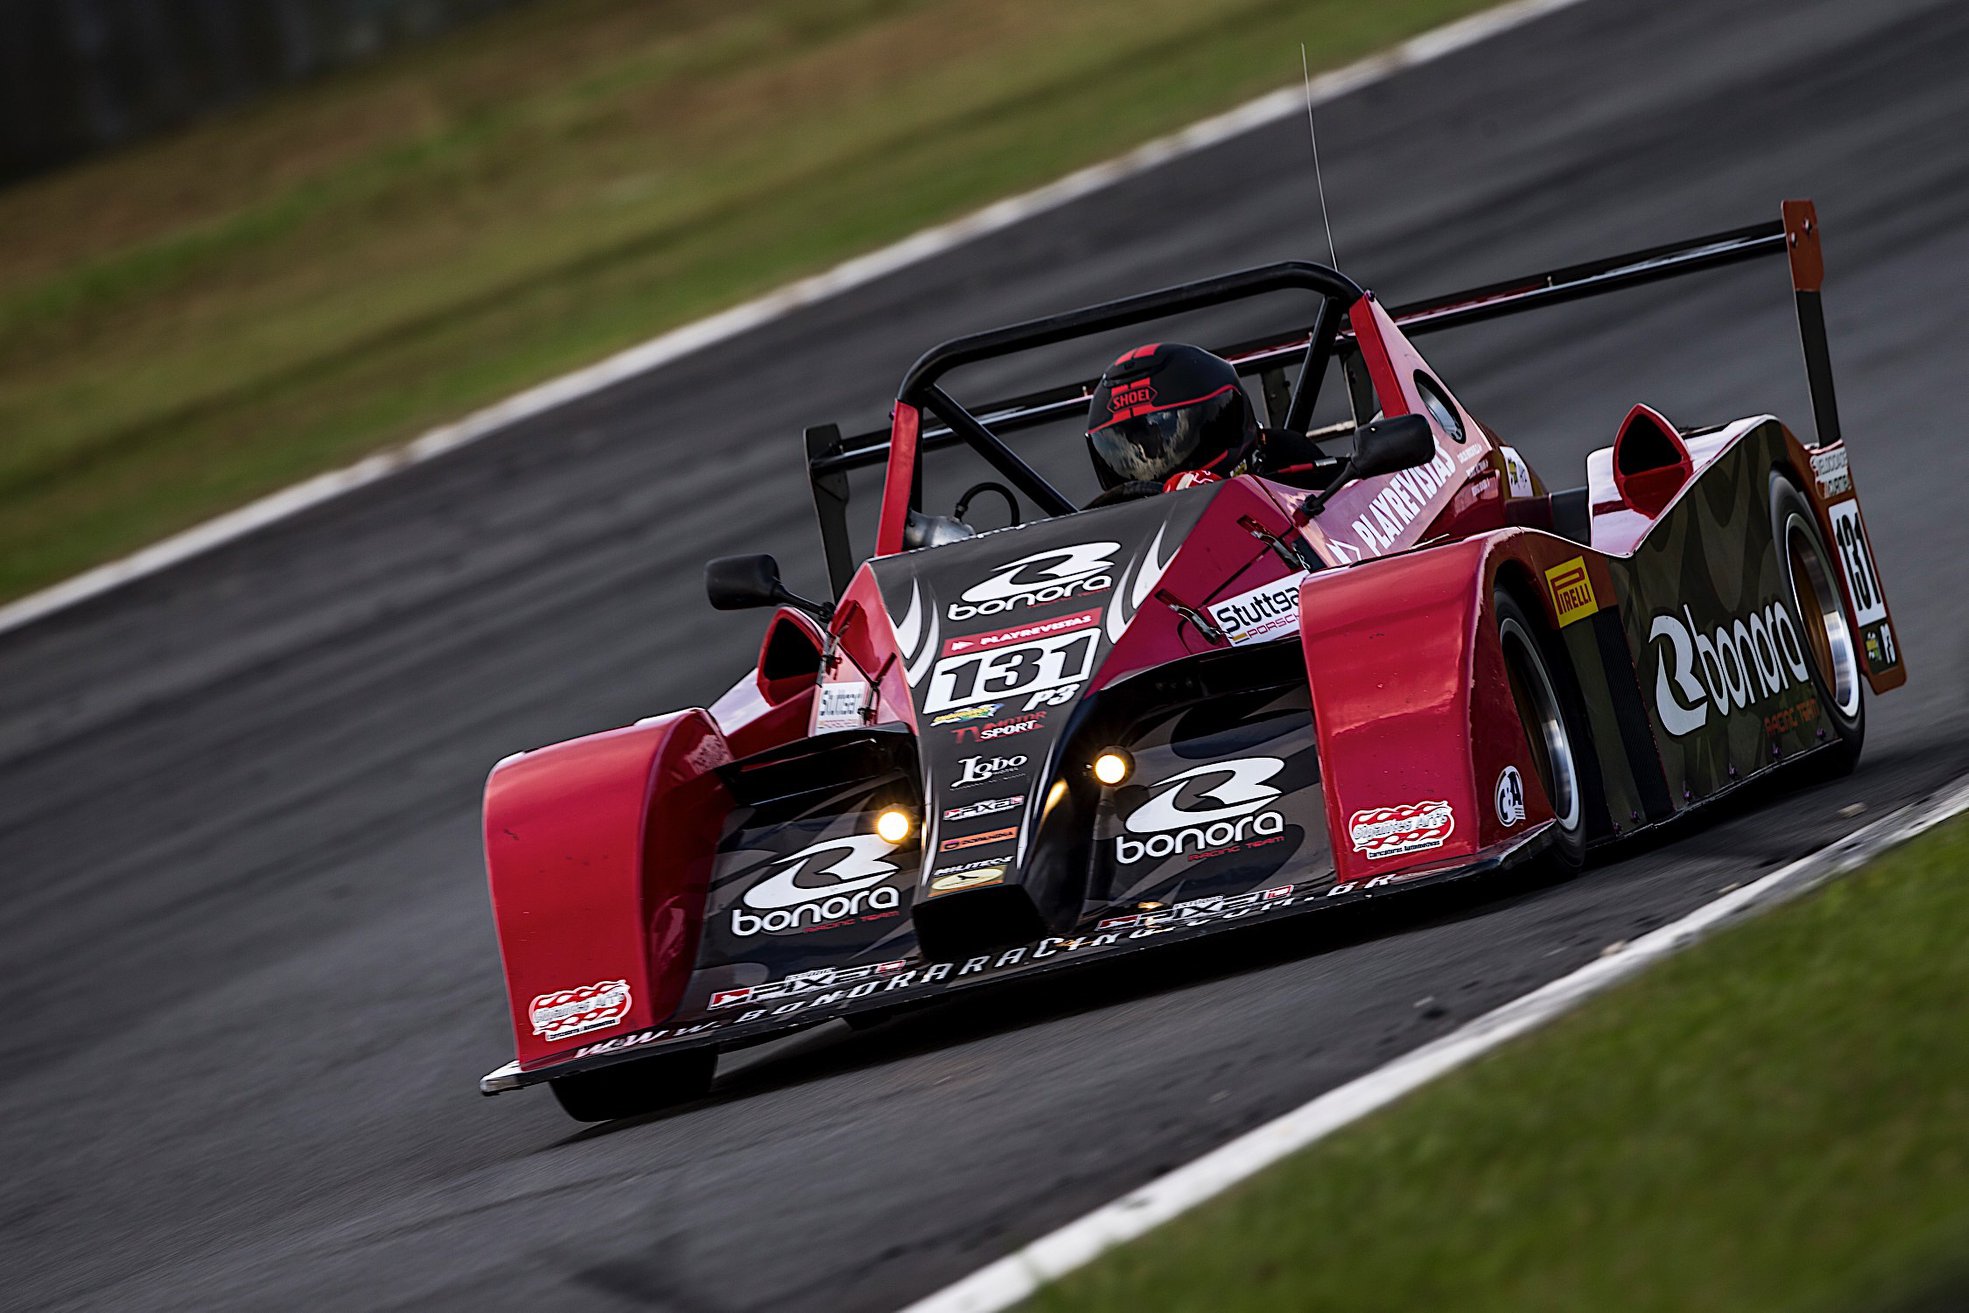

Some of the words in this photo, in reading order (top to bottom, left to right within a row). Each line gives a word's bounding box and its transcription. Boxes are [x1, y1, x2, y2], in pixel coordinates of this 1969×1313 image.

[1112, 387, 1151, 410] SHOEI
[1835, 511, 1882, 612] 131
[947, 575, 1113, 621] bonora
[1550, 566, 1593, 615] PIRELLI
[979, 614, 1093, 646] PLAYREVISTAS
[940, 635, 1093, 702] 131
[1683, 601, 1810, 716] bonora
[1021, 683, 1081, 713] P3
[980, 719, 1038, 740] SPORT
[950, 755, 1028, 788] Lobo
[1115, 811, 1285, 865] bonora
[732, 886, 900, 937] bonora
